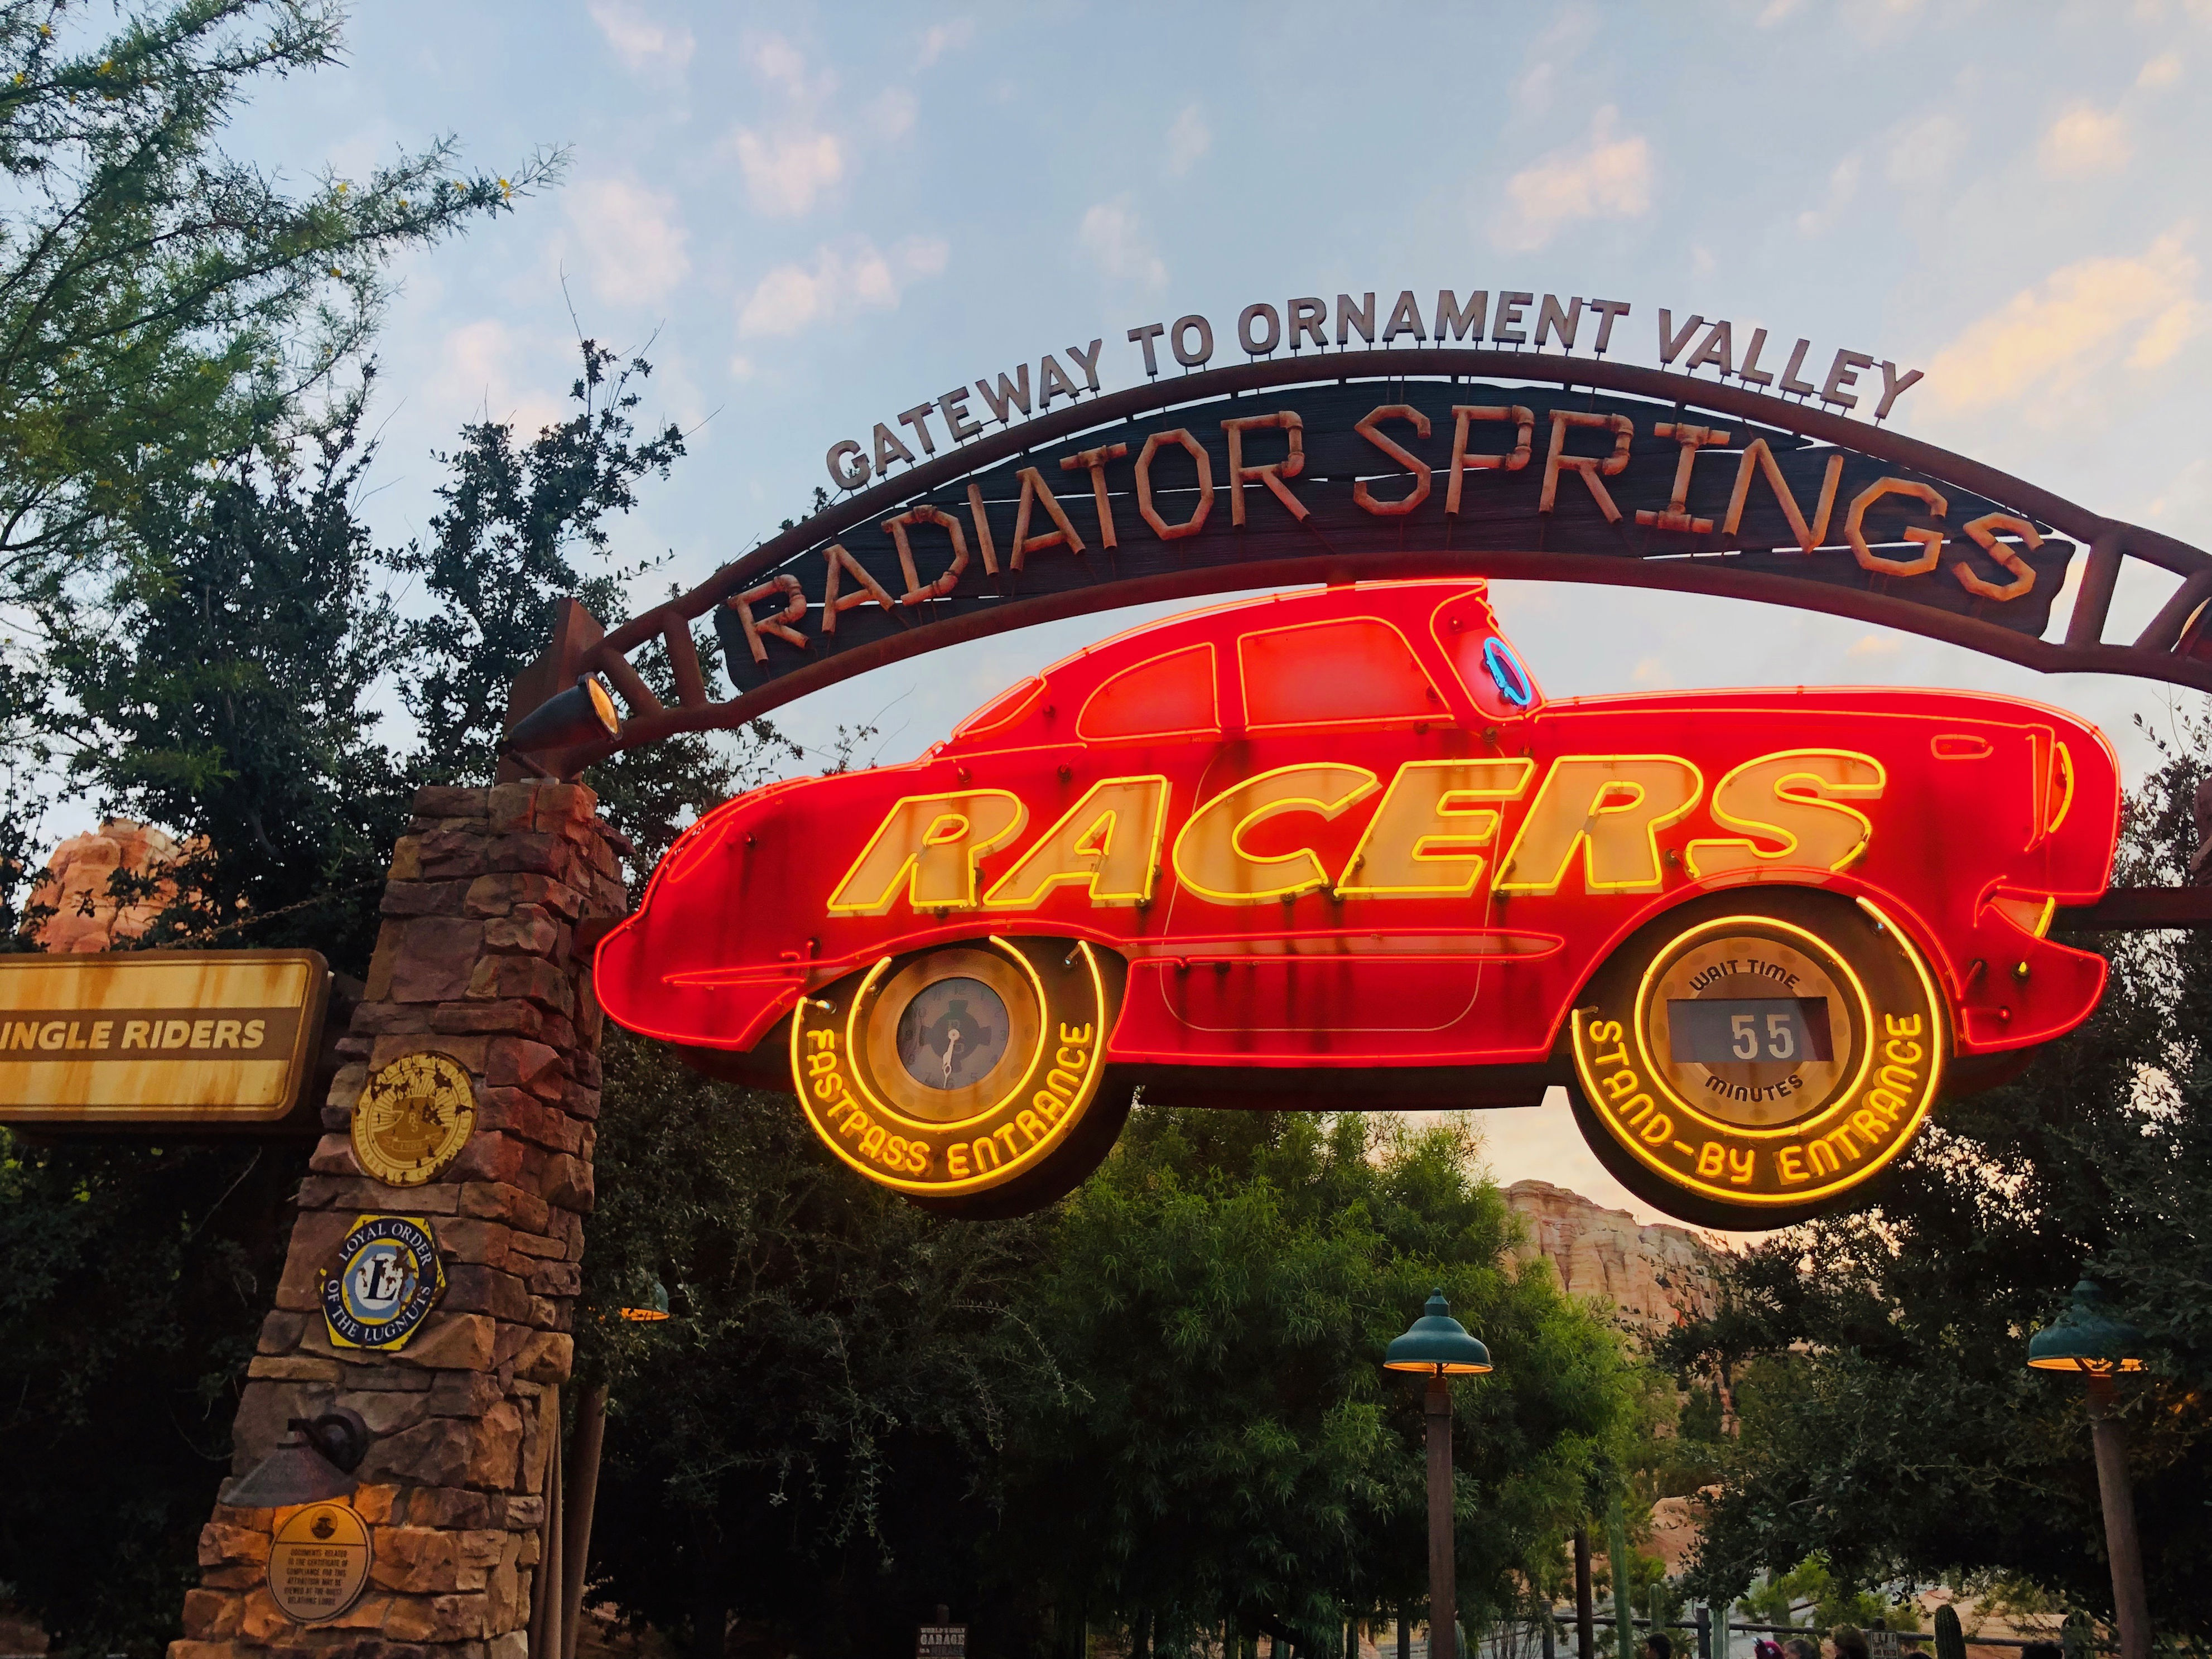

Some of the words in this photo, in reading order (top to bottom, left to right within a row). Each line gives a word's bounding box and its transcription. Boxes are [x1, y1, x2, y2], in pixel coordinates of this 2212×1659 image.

[826, 338, 1102, 491] GATEWAY
[1127, 314, 1214, 377] TO
[1237, 289, 1631, 356] ORNAMENT
[1657, 307, 1925, 419] VALLEY
[727, 410, 1310, 665] RADIATOR
[1352, 403, 2045, 602] SPRINGS
[826, 747, 1890, 918] RACERS
[1689, 959, 1738, 991] WAIT
[1747, 959, 1800, 989] TIME
[121, 1019, 266, 1049] RIDERS
[1731, 1014, 1795, 1059] 55
[807, 1029, 931, 1173] FASTPASS
[948, 1022, 1091, 1176] ENTRANCE
[1705, 1074, 1804, 1103] MINUTES
[1779, 1012, 1922, 1181] ENTRANCE
[339, 1223, 386, 1261] LOYAL
[391, 1223, 432, 1265] ORDER
[327, 1280, 340, 1302] OF
[363, 1255, 397, 1301] L
[331, 1305, 359, 1338] THE
[364, 1286, 431, 1342] LUGNUTS
[920, 1634, 965, 1645] GARAGE
